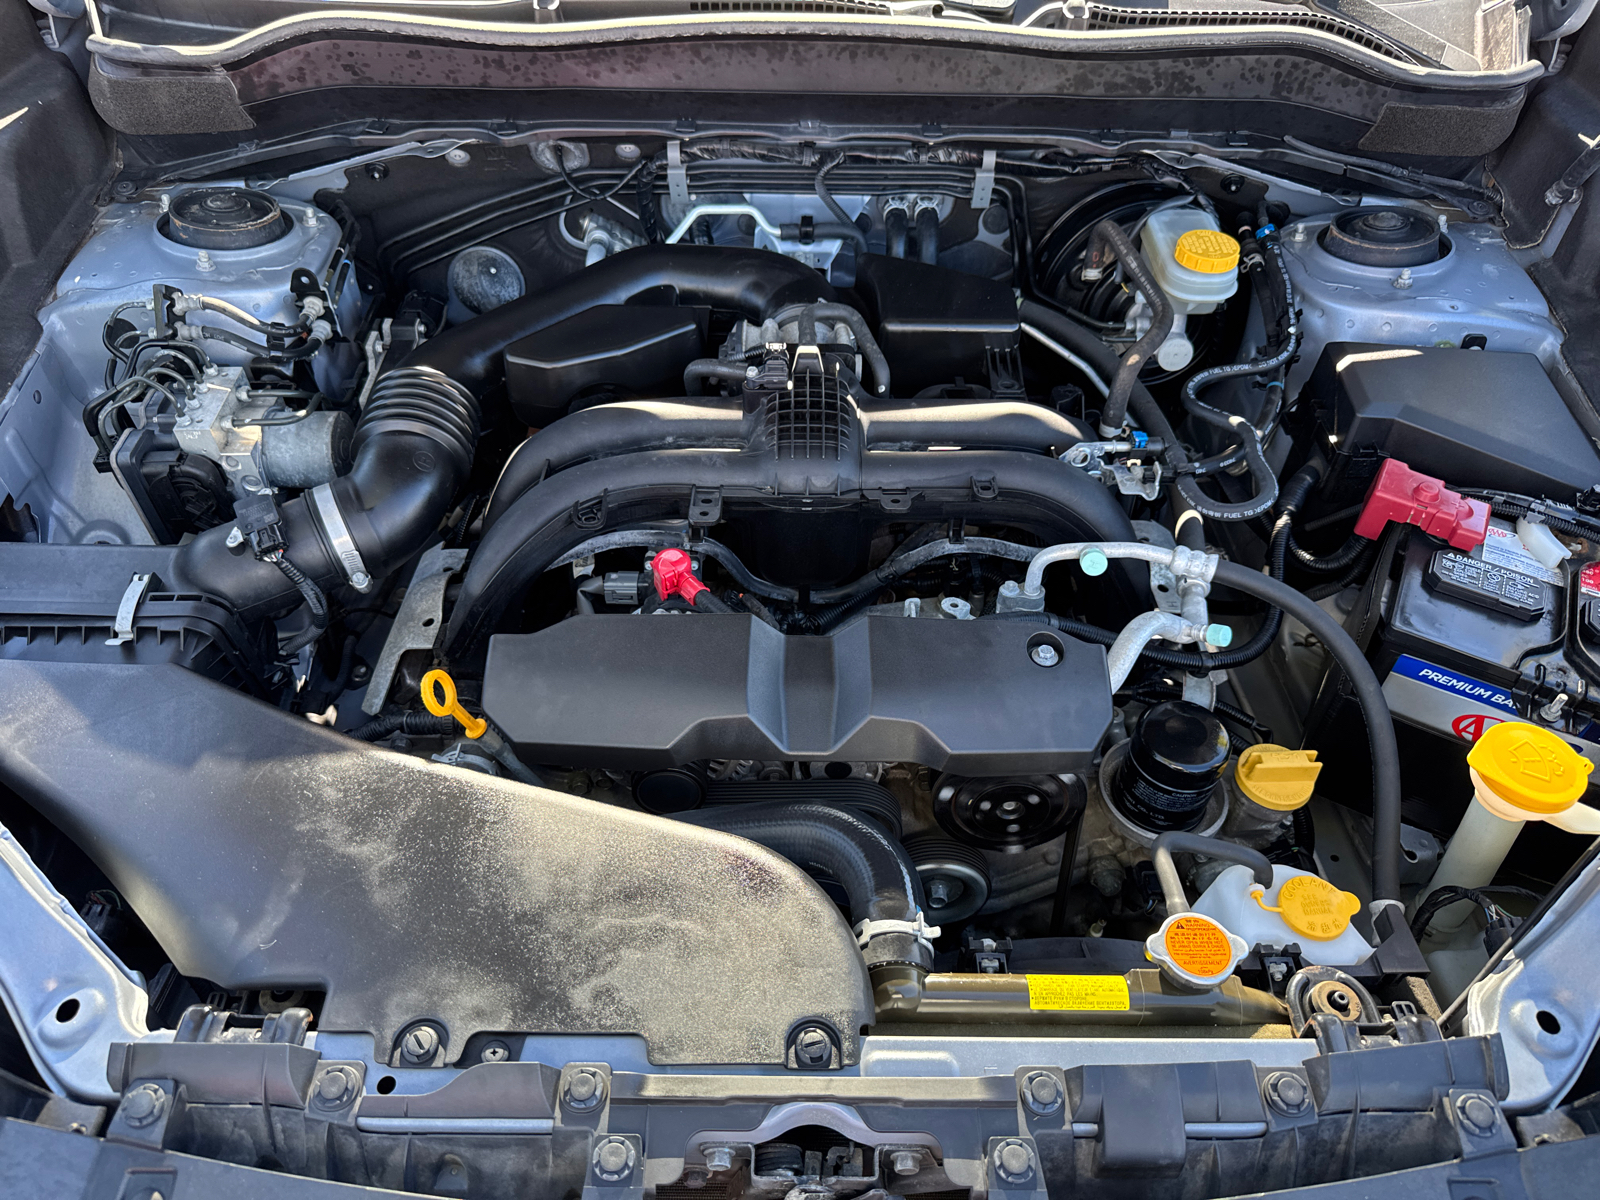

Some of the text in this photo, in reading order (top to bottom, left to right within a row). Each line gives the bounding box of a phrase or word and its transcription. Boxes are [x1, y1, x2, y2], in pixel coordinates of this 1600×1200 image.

[1456, 554, 1492, 570] DANGER
[1500, 569, 1534, 584] POISON
[1418, 668, 1490, 699] PREMIUM
[1282, 877, 1336, 899] COOLANT
[1303, 907, 1334, 916] MANUAL
